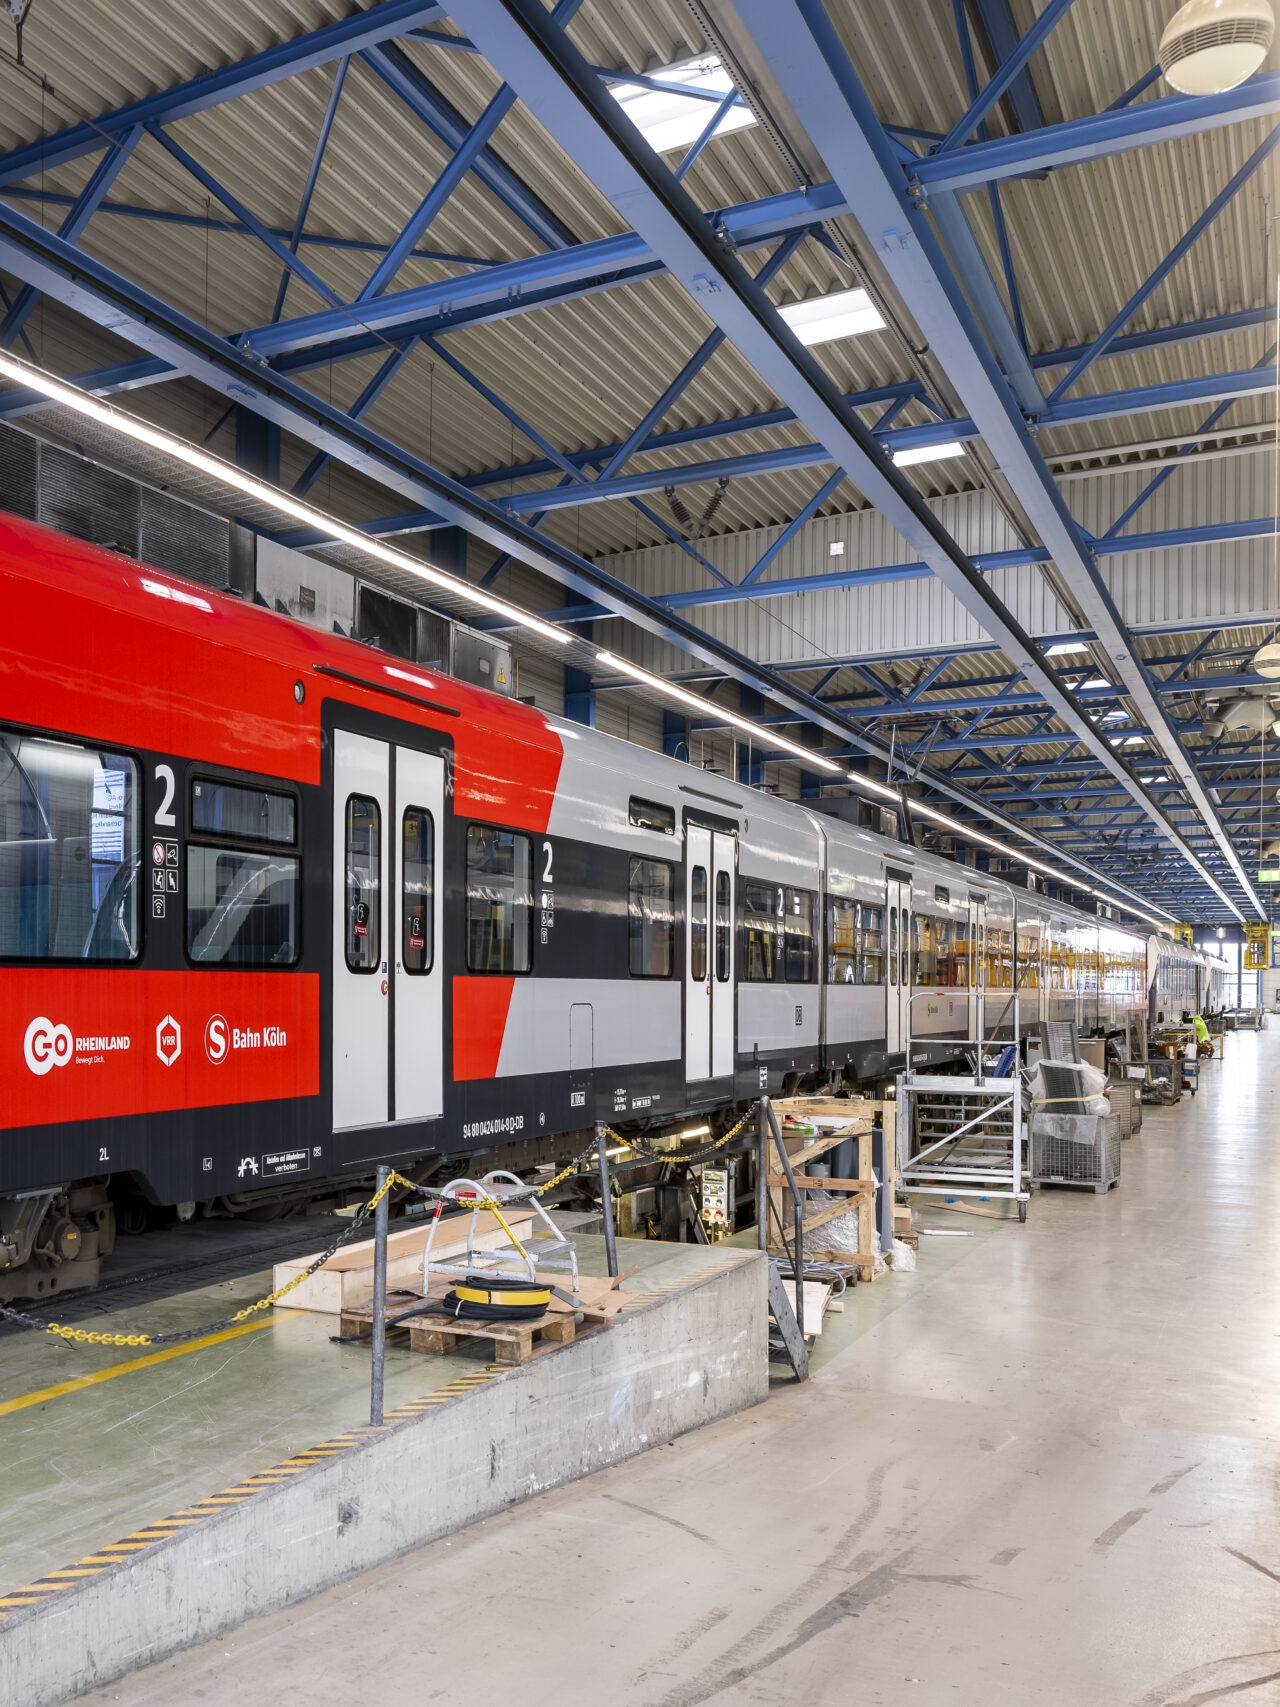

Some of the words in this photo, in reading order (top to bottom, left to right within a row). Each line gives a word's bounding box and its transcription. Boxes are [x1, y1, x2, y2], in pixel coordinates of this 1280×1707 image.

[154, 764, 176, 827] 2
[543, 841, 553, 883] 2
[777, 887, 785, 917] 2
[75, 1036, 130, 1052] RHEINLAND
[161, 1035, 176, 1047] VRR
[208, 1018, 227, 1060] S
[233, 1027, 260, 1049] Bahn
[263, 1026, 287, 1048] Köln
[75, 1056, 93, 1066] Bewegt
[471, 1122, 480, 1137] 80
[99, 1147, 109, 1161] 2L
[274, 1162, 298, 1173] verboten
